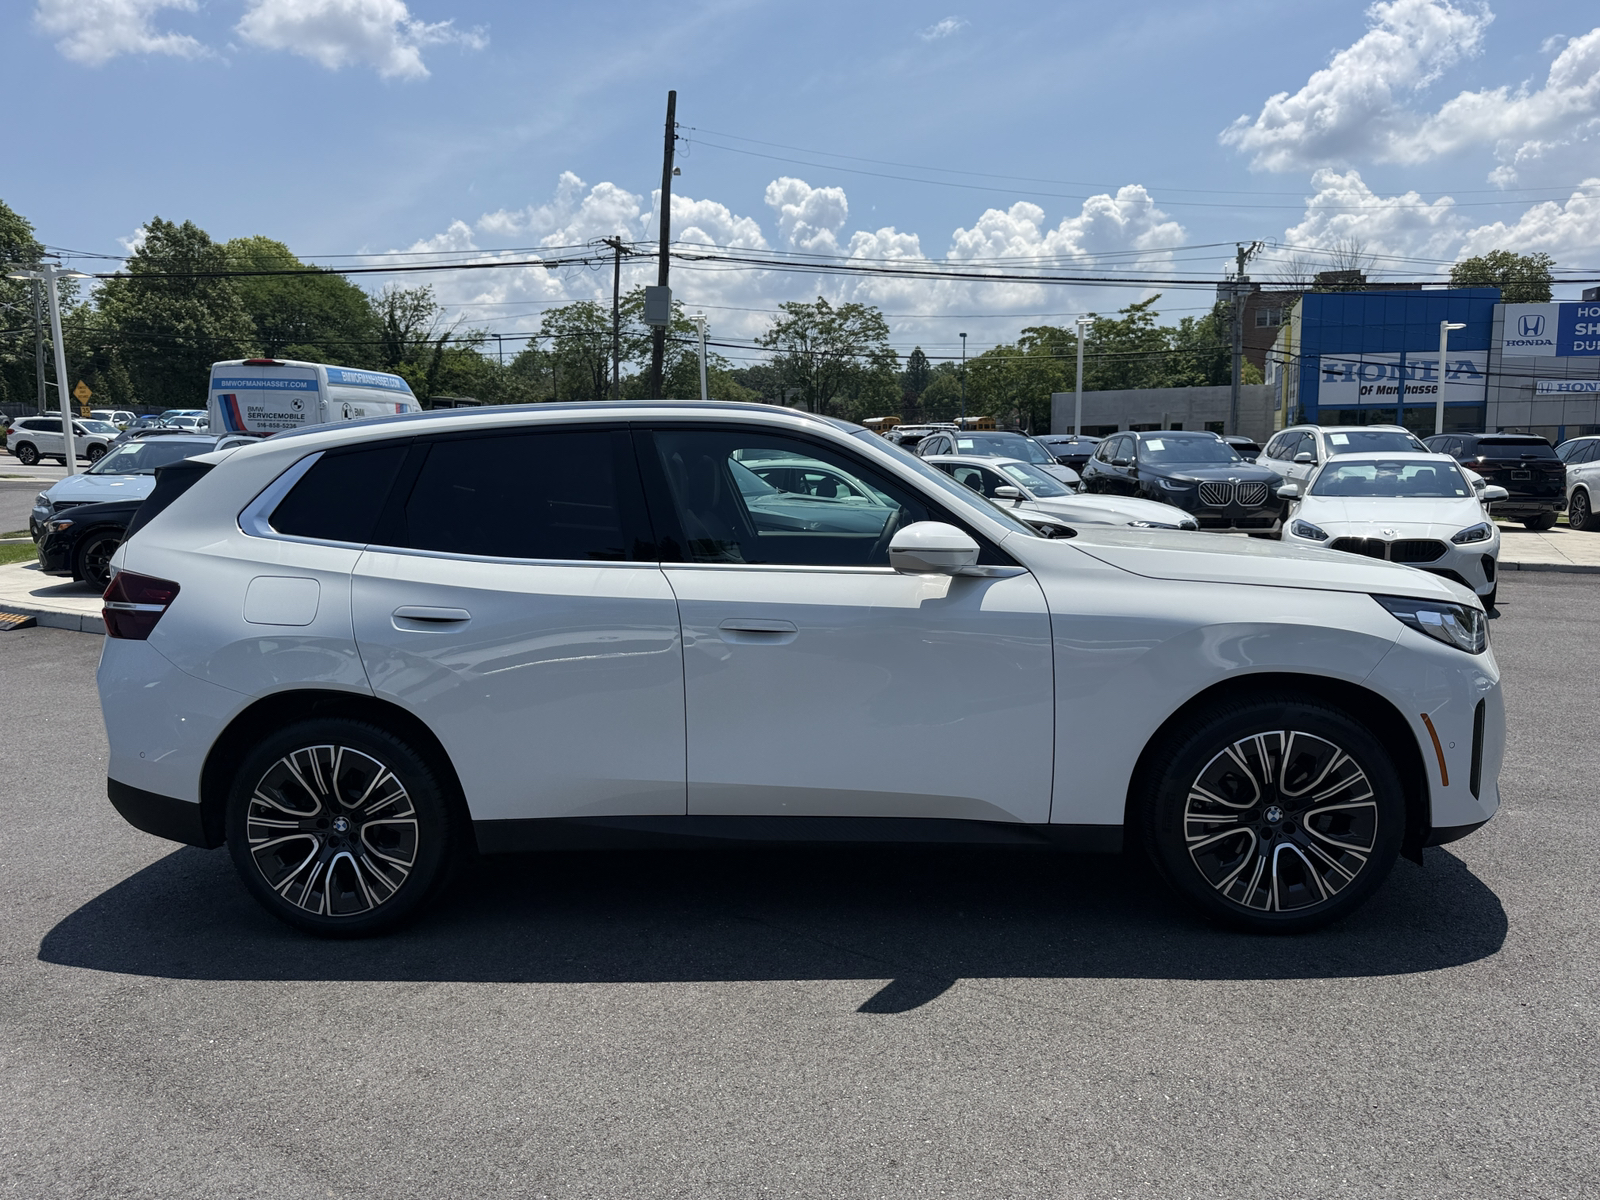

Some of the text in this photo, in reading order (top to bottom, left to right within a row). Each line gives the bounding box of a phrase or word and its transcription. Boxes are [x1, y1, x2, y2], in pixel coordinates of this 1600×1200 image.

[1506, 339, 1554, 347] HONDA
[1573, 340, 1600, 351] DU
[1322, 360, 1483, 383] HONDA
[221, 380, 307, 388] BMWOFMANHASSET.COM
[341, 371, 401, 388] BMWOFMANHASSET.COM
[1376, 384, 1438, 395] Manhasse
[1557, 382, 1600, 392] HON
